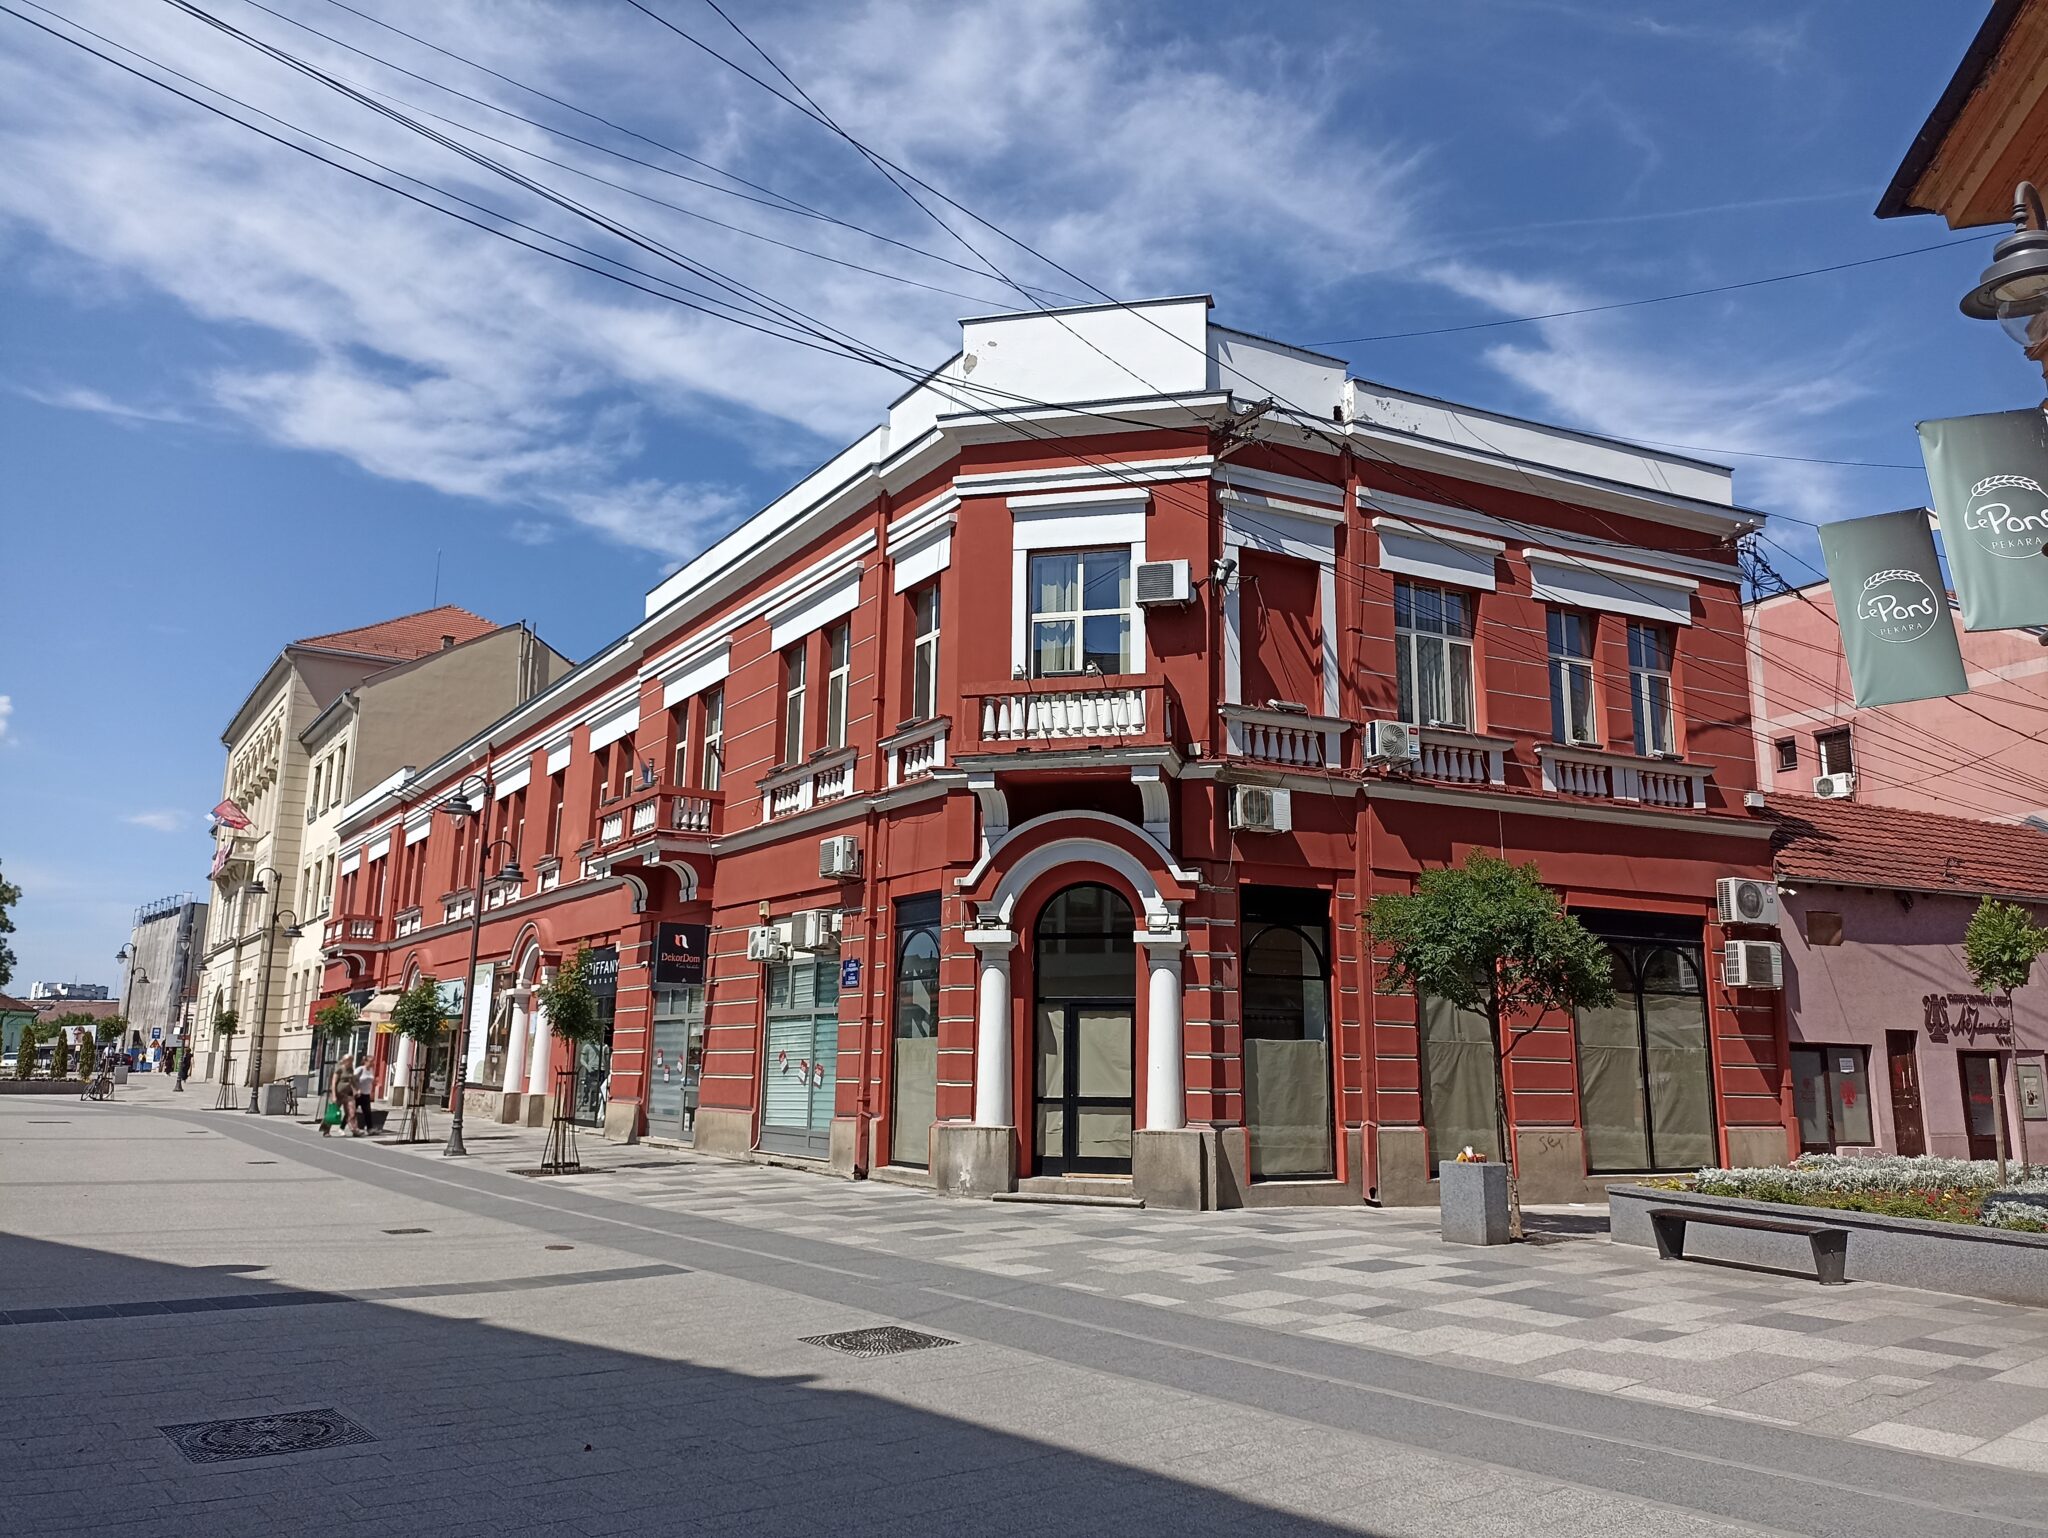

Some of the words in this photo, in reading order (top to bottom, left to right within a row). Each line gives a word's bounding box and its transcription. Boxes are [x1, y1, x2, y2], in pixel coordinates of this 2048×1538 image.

[1991, 536, 2042, 549] PEKARA
[1880, 622, 1923, 635] PEKARA
[661, 952, 701, 963] DekorDom
